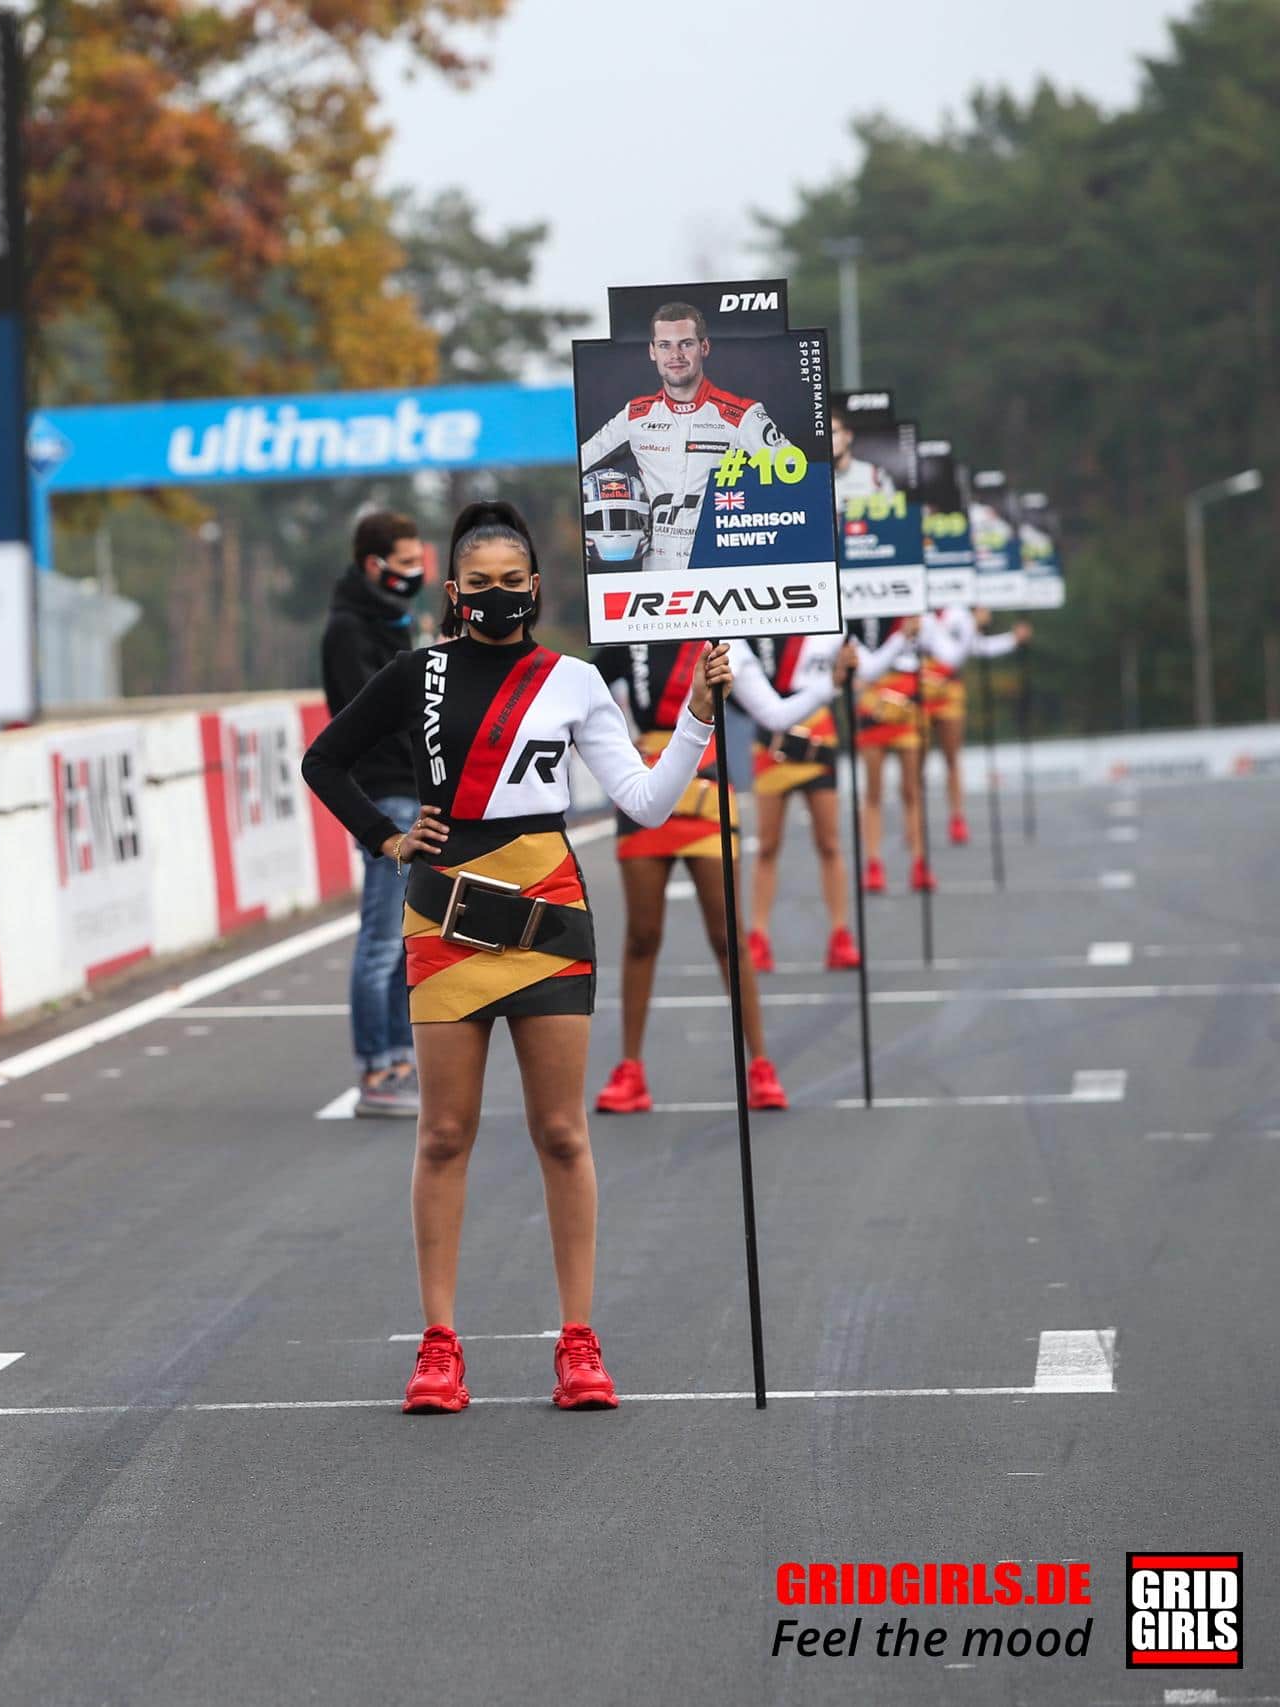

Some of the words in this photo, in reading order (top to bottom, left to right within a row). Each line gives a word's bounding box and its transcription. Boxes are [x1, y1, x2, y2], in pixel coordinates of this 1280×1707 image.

[720, 292, 778, 312] DTM
[799, 341, 809, 383] SPORT
[811, 340, 824, 437] PERFORMANCE
[167, 398, 482, 475] ultimate
[714, 447, 808, 487] #10
[670, 527, 695, 535] TURISM
[715, 512, 806, 529] HARRISON
[716, 532, 778, 547] NEWEY
[471, 610, 484, 622] R
[628, 586, 818, 617] REMUS
[628, 621, 712, 631] PERFORMANCE
[718, 618, 753, 627] SPORT
[760, 615, 819, 625] EXHAUSTS
[423, 650, 447, 786] REMUS
[507, 740, 564, 784] R
